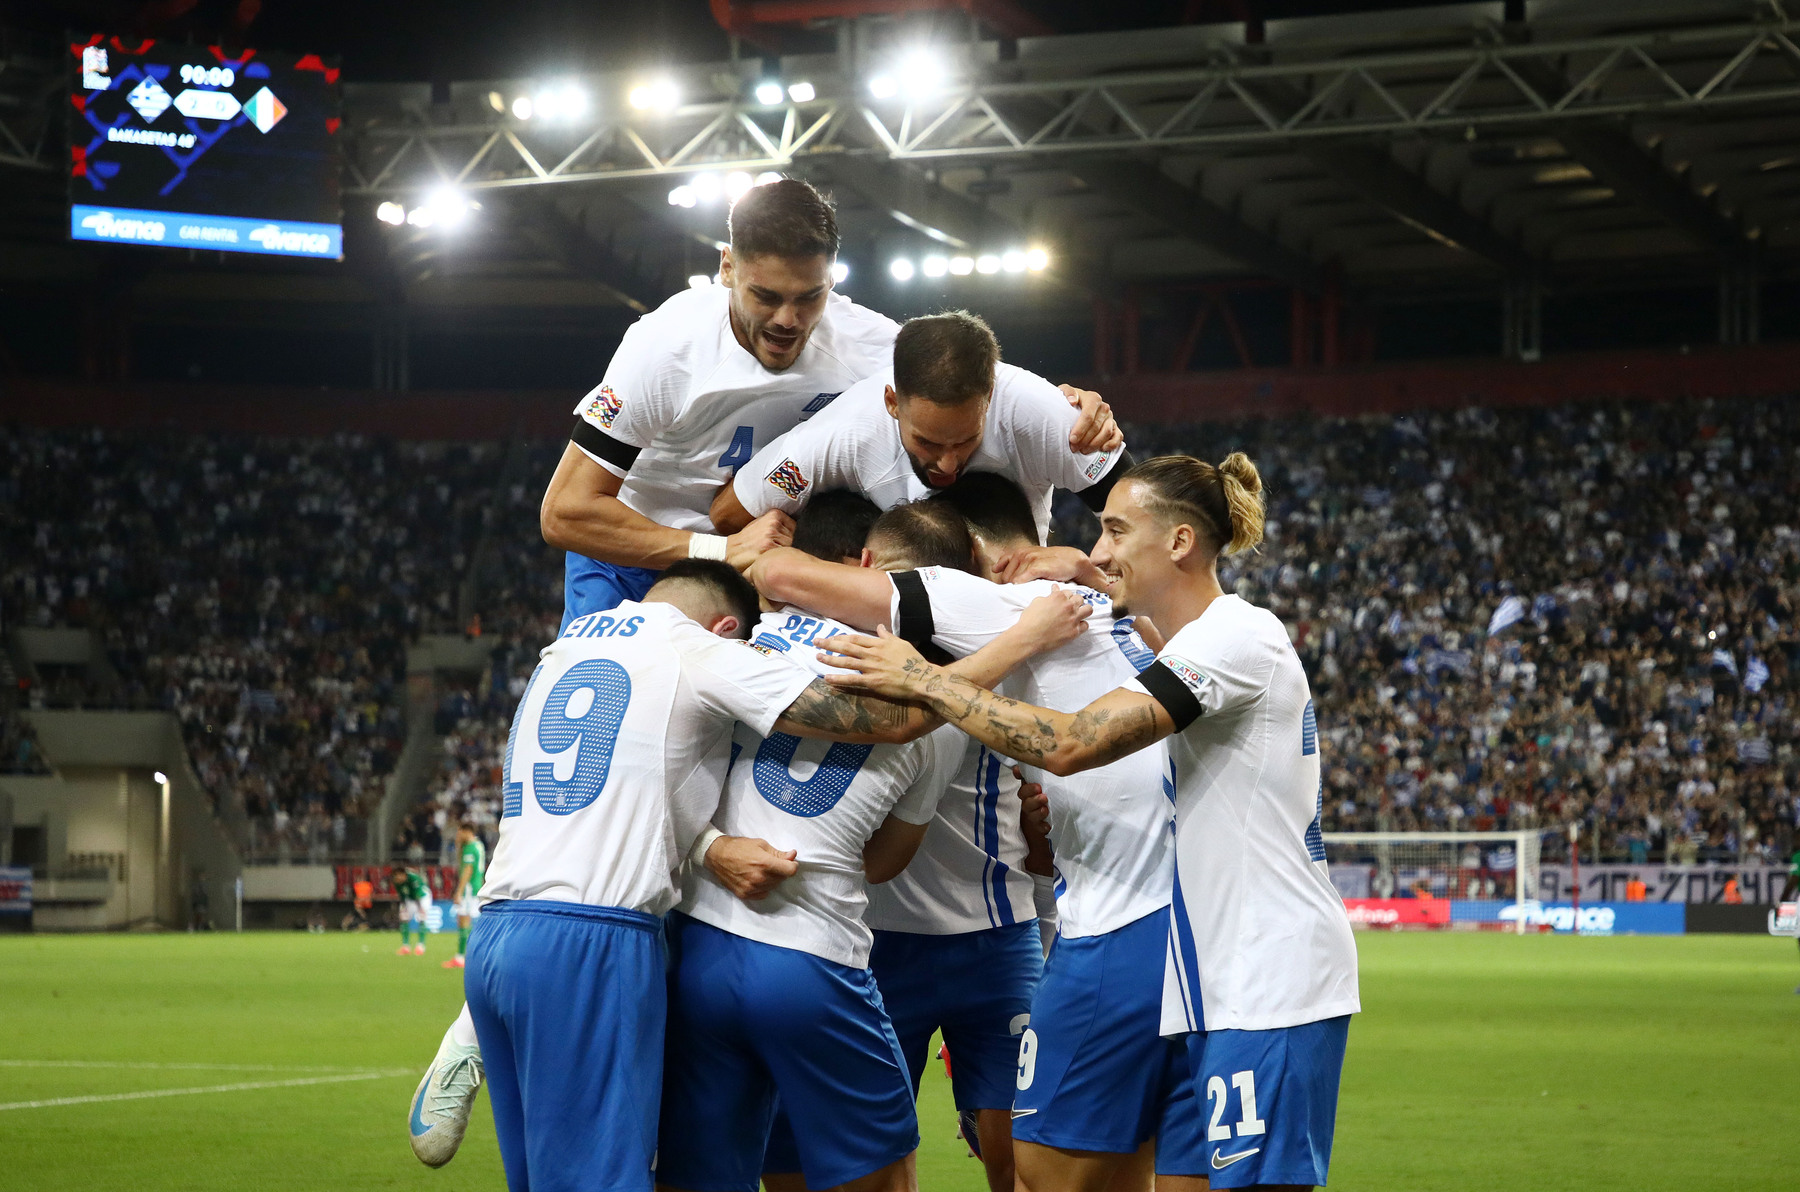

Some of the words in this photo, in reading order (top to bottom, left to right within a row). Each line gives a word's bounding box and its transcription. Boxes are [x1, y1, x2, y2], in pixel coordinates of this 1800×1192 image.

[180, 64, 235, 88] 90:00
[91, 214, 166, 241] avance
[257, 226, 331, 253] avance
[718, 426, 754, 477] 4
[503, 658, 632, 817] 19
[1016, 1028, 1039, 1091] 9
[1207, 1070, 1266, 1142] 21
